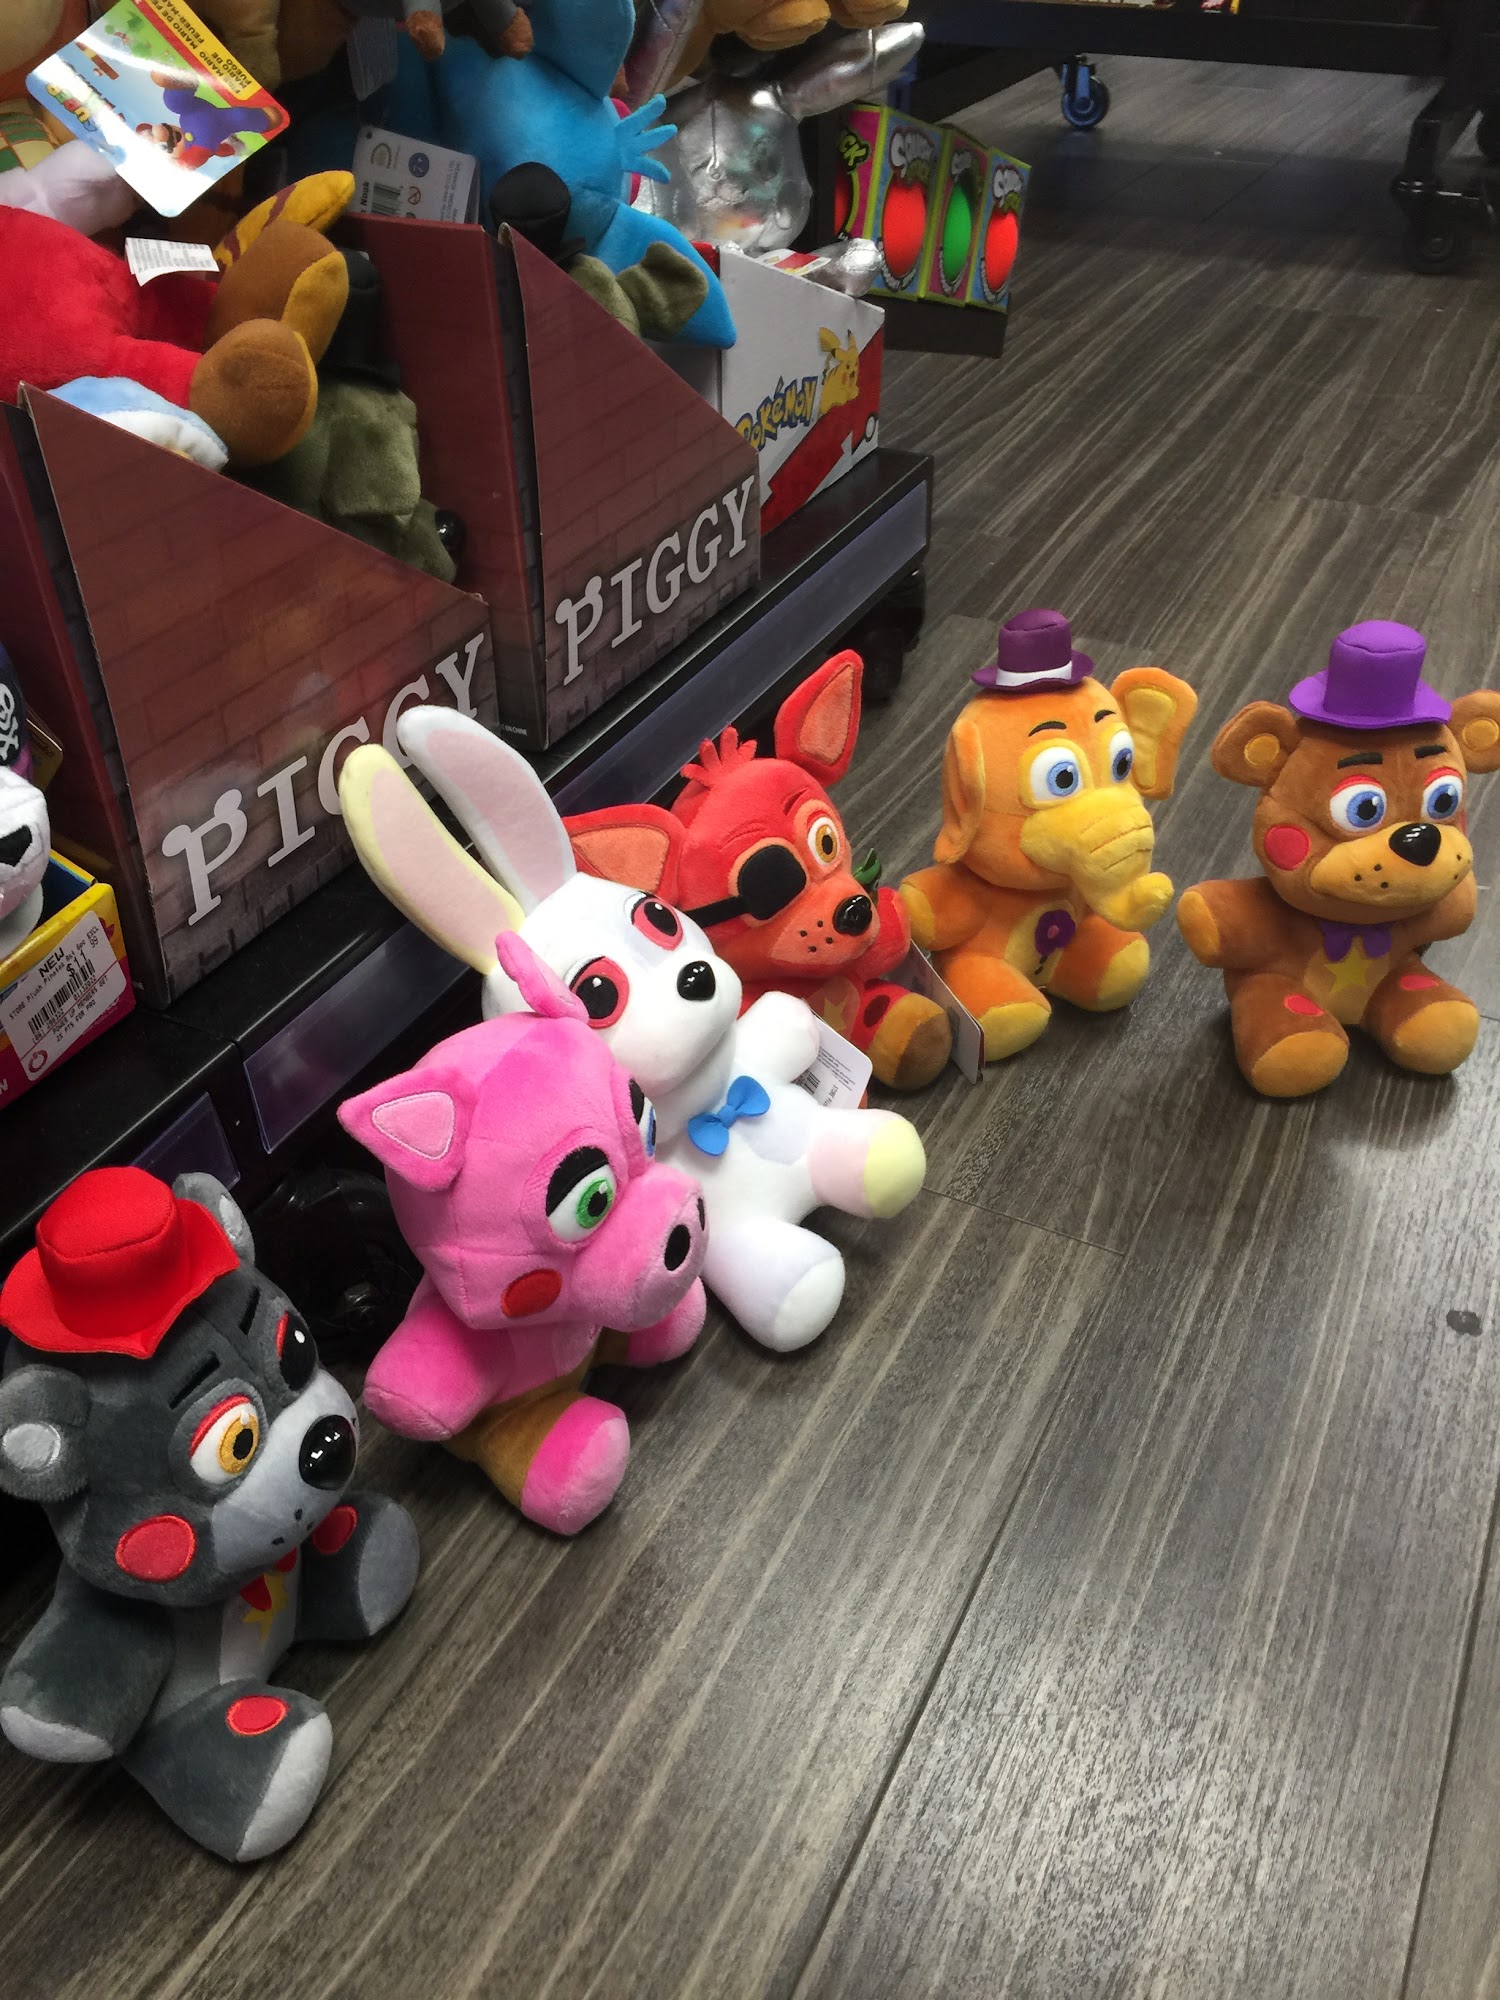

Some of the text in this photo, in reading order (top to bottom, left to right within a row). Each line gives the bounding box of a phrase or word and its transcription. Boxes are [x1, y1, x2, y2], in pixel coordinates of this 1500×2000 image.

[161, 9, 174, 23] DE
[172, 22, 199, 50] MARIO
[199, 51, 224, 77] MARIO
[211, 52, 248, 89] MARIO DE
[226, 58, 252, 86] FUEGO
[556, 474, 756, 686] PIGGY
[9, 1001, 26, 1020] STORE
[26, 984, 43, 1003] Plush
[86, 925, 99, 940] EXCL
[39, 947, 64, 978] NEW
